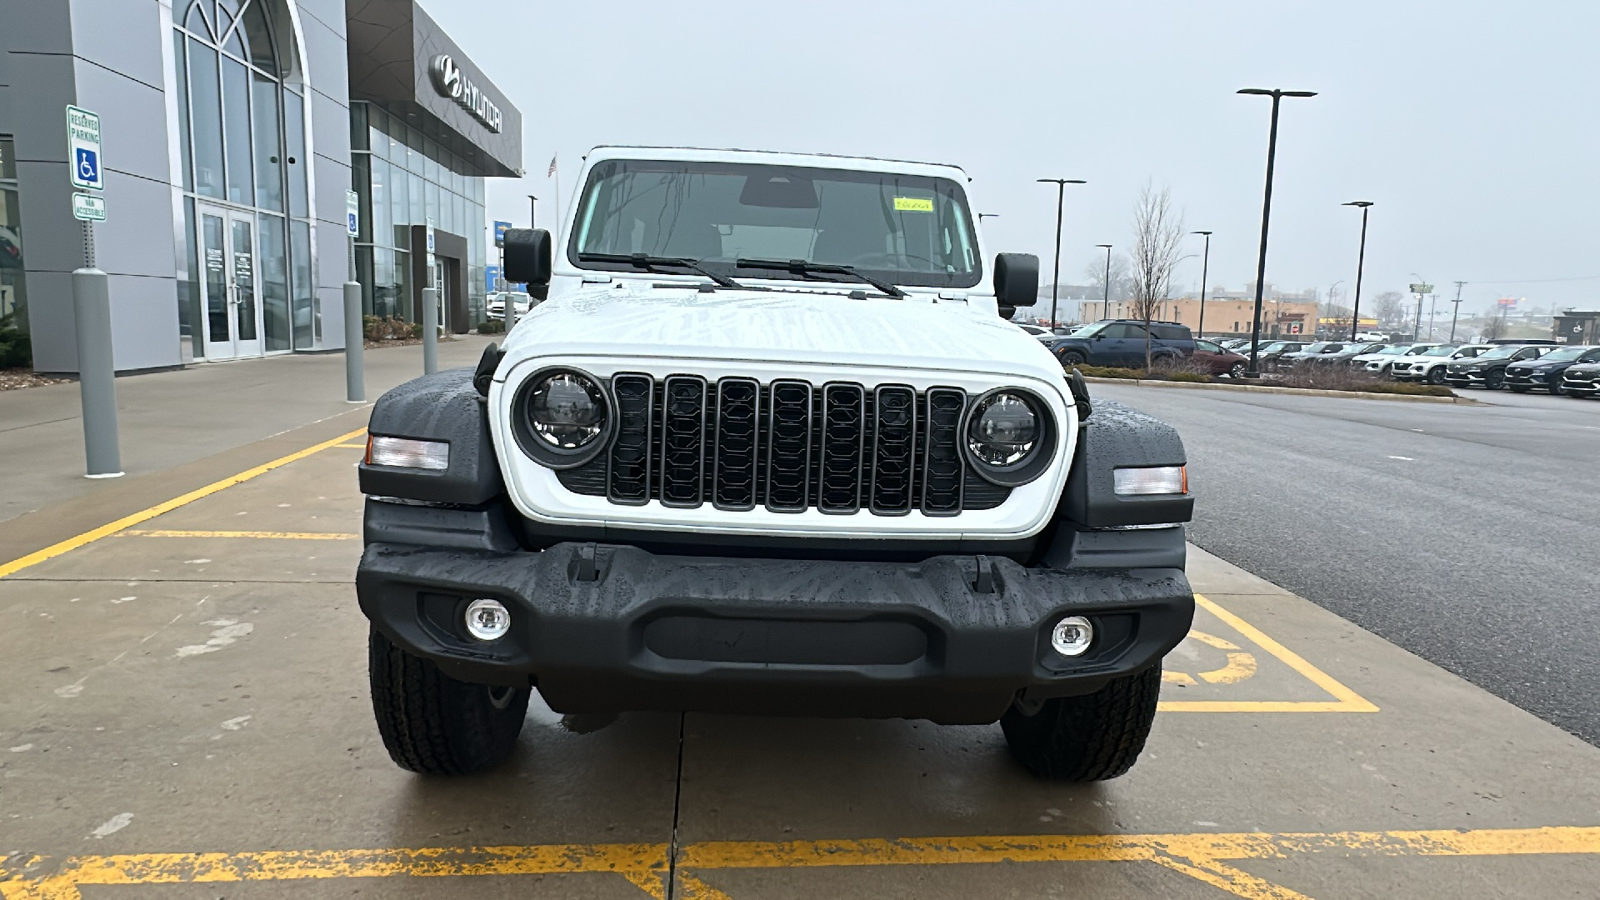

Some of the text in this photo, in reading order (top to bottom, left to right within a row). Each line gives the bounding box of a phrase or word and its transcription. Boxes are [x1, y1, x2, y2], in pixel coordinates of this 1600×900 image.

[463, 76, 503, 134] HYUNDAI
[71, 114, 98, 131] RESERVED
[71, 127, 99, 144] PARKING
[76, 206, 104, 217] ACCESSIBLE
